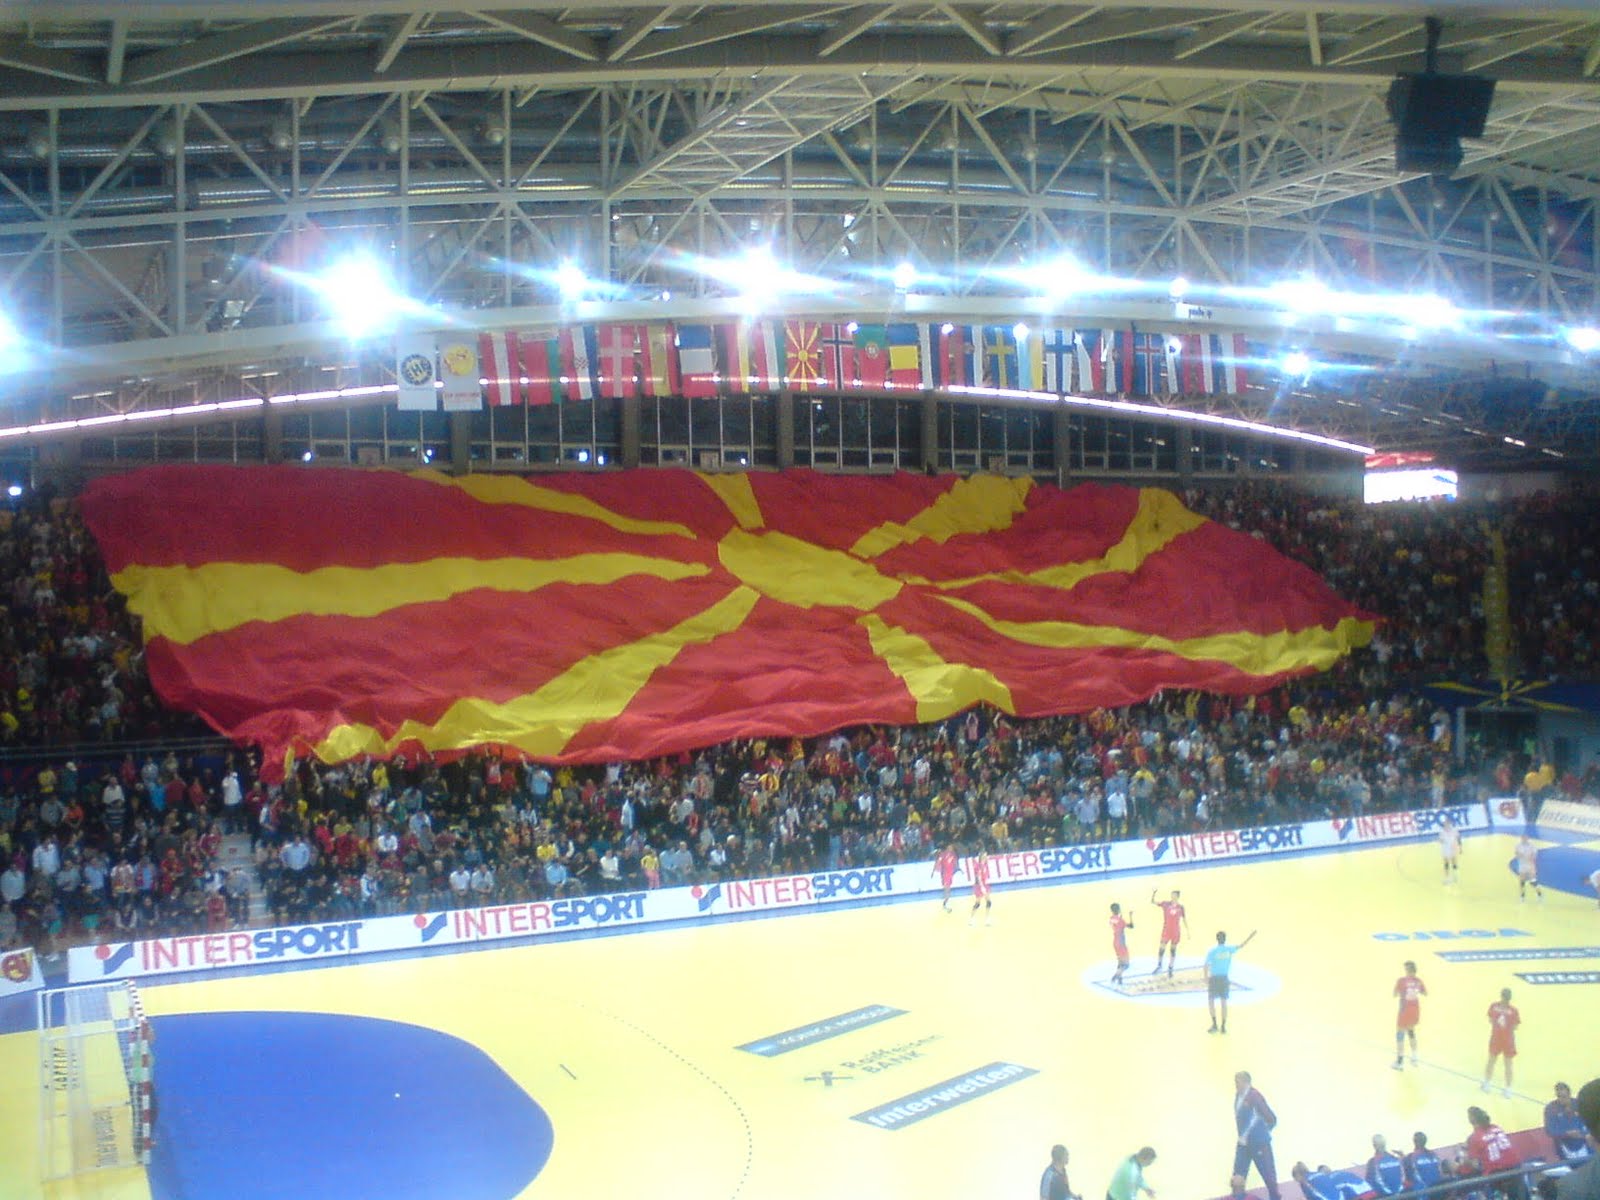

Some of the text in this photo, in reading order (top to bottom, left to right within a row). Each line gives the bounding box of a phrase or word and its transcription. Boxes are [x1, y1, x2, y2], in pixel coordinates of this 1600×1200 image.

[1173, 826, 1303, 859] INTERSPORT
[1357, 808, 1470, 838] INTERSPORT
[727, 868, 895, 908] INTERSPORT
[454, 893, 647, 939] INTERSPORT
[141, 922, 364, 971] INTERSPORT
[862, 1050, 928, 1073] BANK
[868, 1064, 1025, 1127] Interwetten
